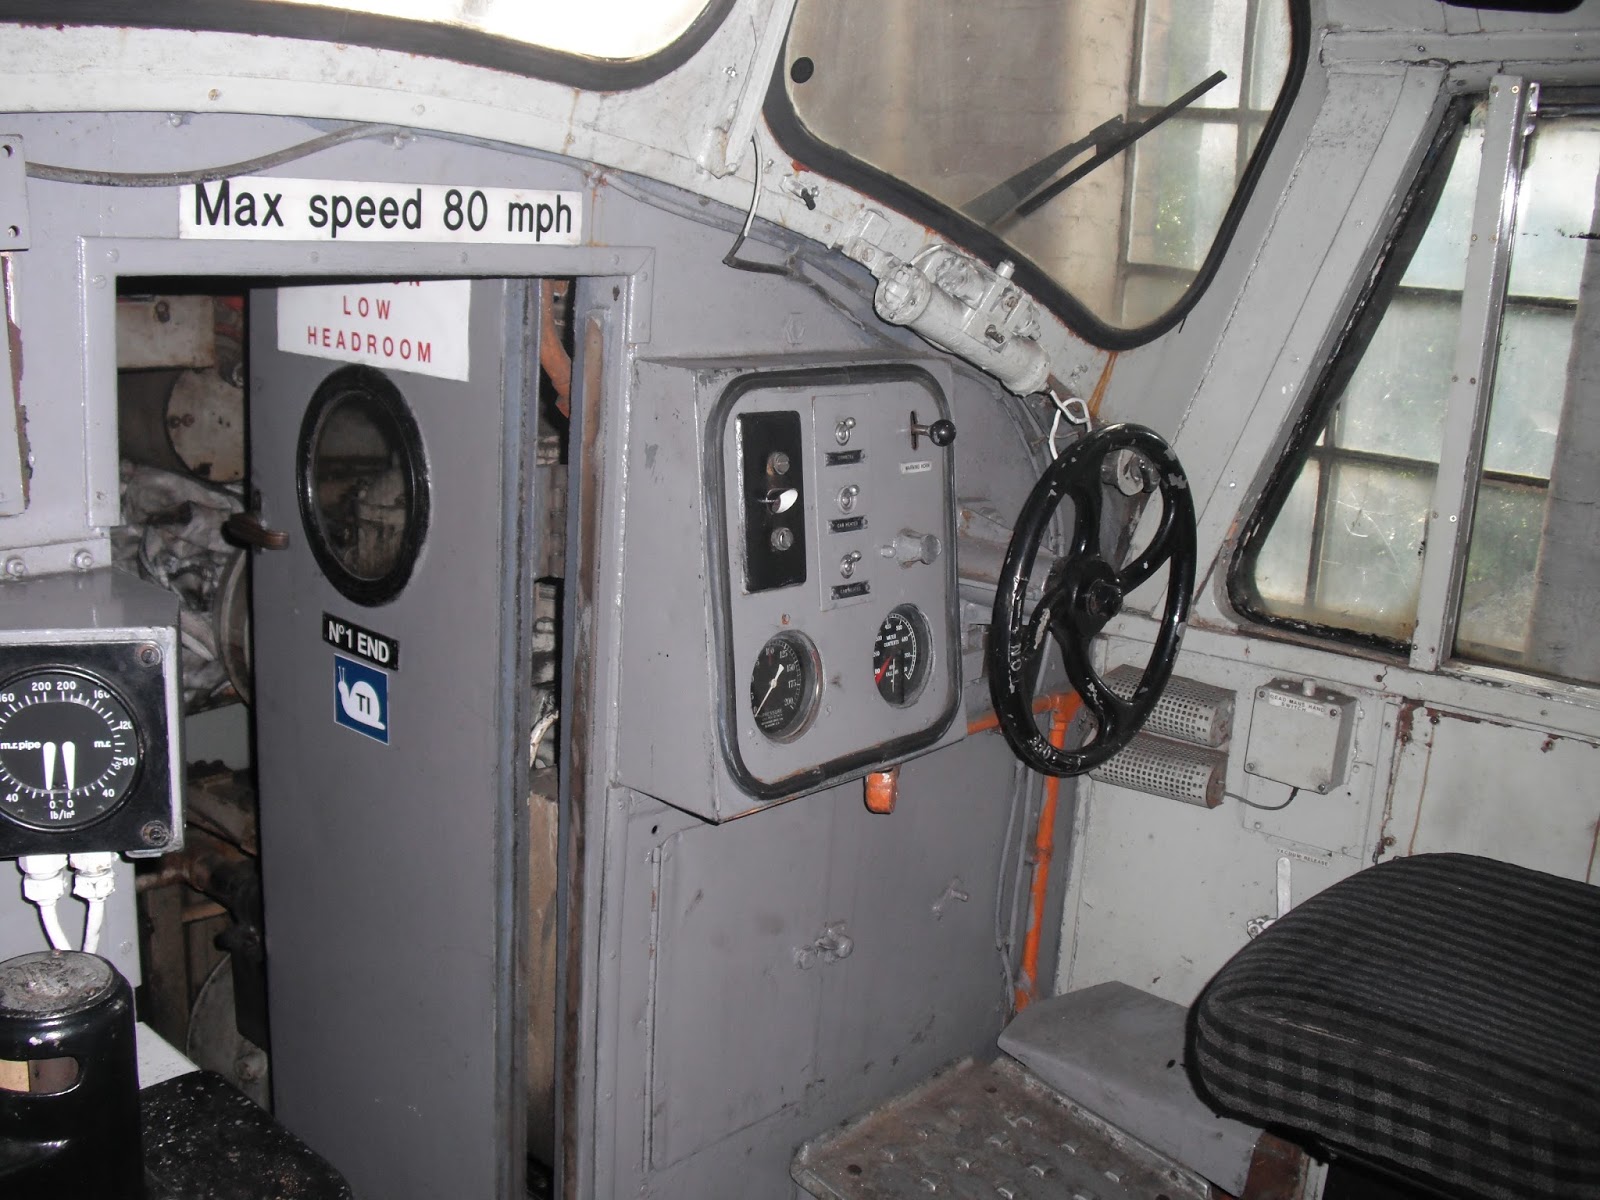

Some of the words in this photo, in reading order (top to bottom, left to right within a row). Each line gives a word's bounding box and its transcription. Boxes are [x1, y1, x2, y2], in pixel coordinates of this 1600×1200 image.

[195, 180, 284, 226] Max
[308, 188, 421, 238] speed
[443, 189, 488, 231] 80
[507, 194, 572, 242] mph
[343, 295, 391, 320] LOW
[307, 326, 431, 363] HEADROOM
[357, 631, 390, 663] END
[32, 682, 52, 691] 200
[56, 681, 76, 690] 200
[355, 692, 371, 715] TI
[122, 757, 136, 766] 80
[5, 793, 19, 802] 40
[102, 788, 115, 797] 40
[49, 800, 56, 809] 0
[66, 799, 74, 808] 0
